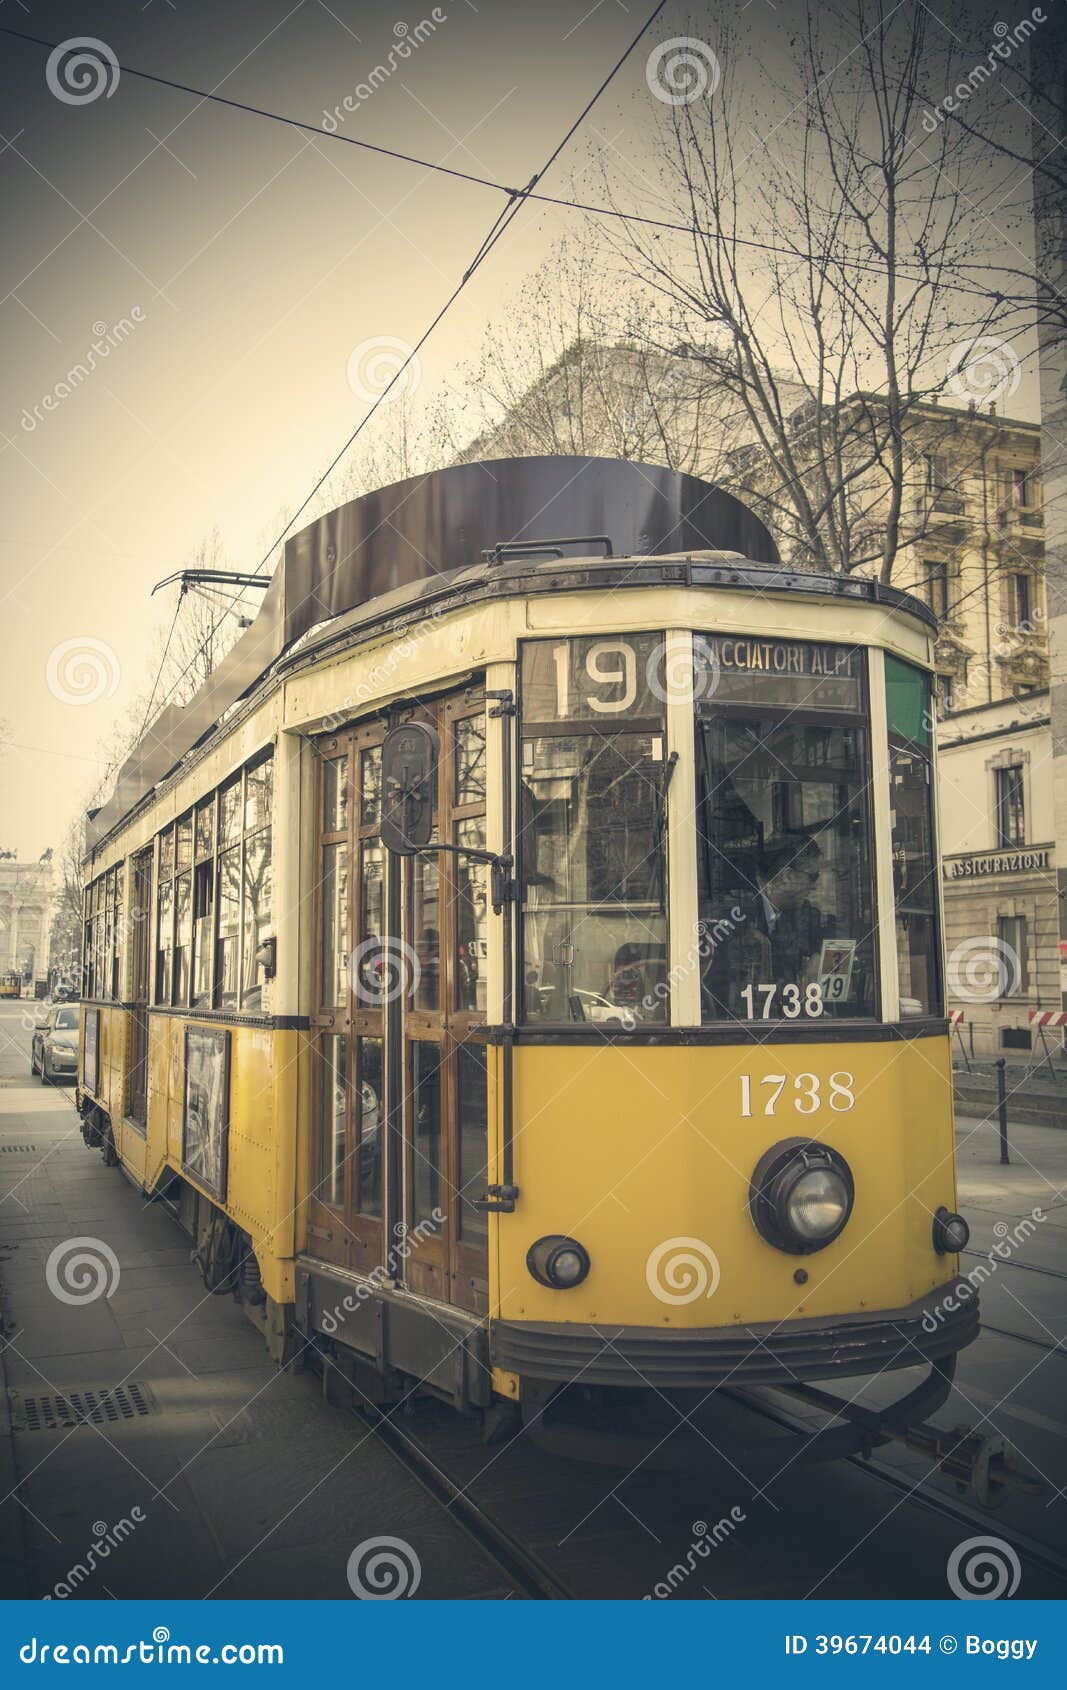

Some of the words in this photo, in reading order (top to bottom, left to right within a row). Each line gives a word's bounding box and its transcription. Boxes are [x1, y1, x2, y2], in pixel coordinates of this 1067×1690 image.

[811, 646, 852, 676] ALPI
[553, 642, 637, 716] 19
[951, 851, 1048, 878] ASSICURAZIONI
[740, 982, 824, 1020] 1738
[822, 977, 844, 998] 19
[740, 1071, 856, 1117] 1738
